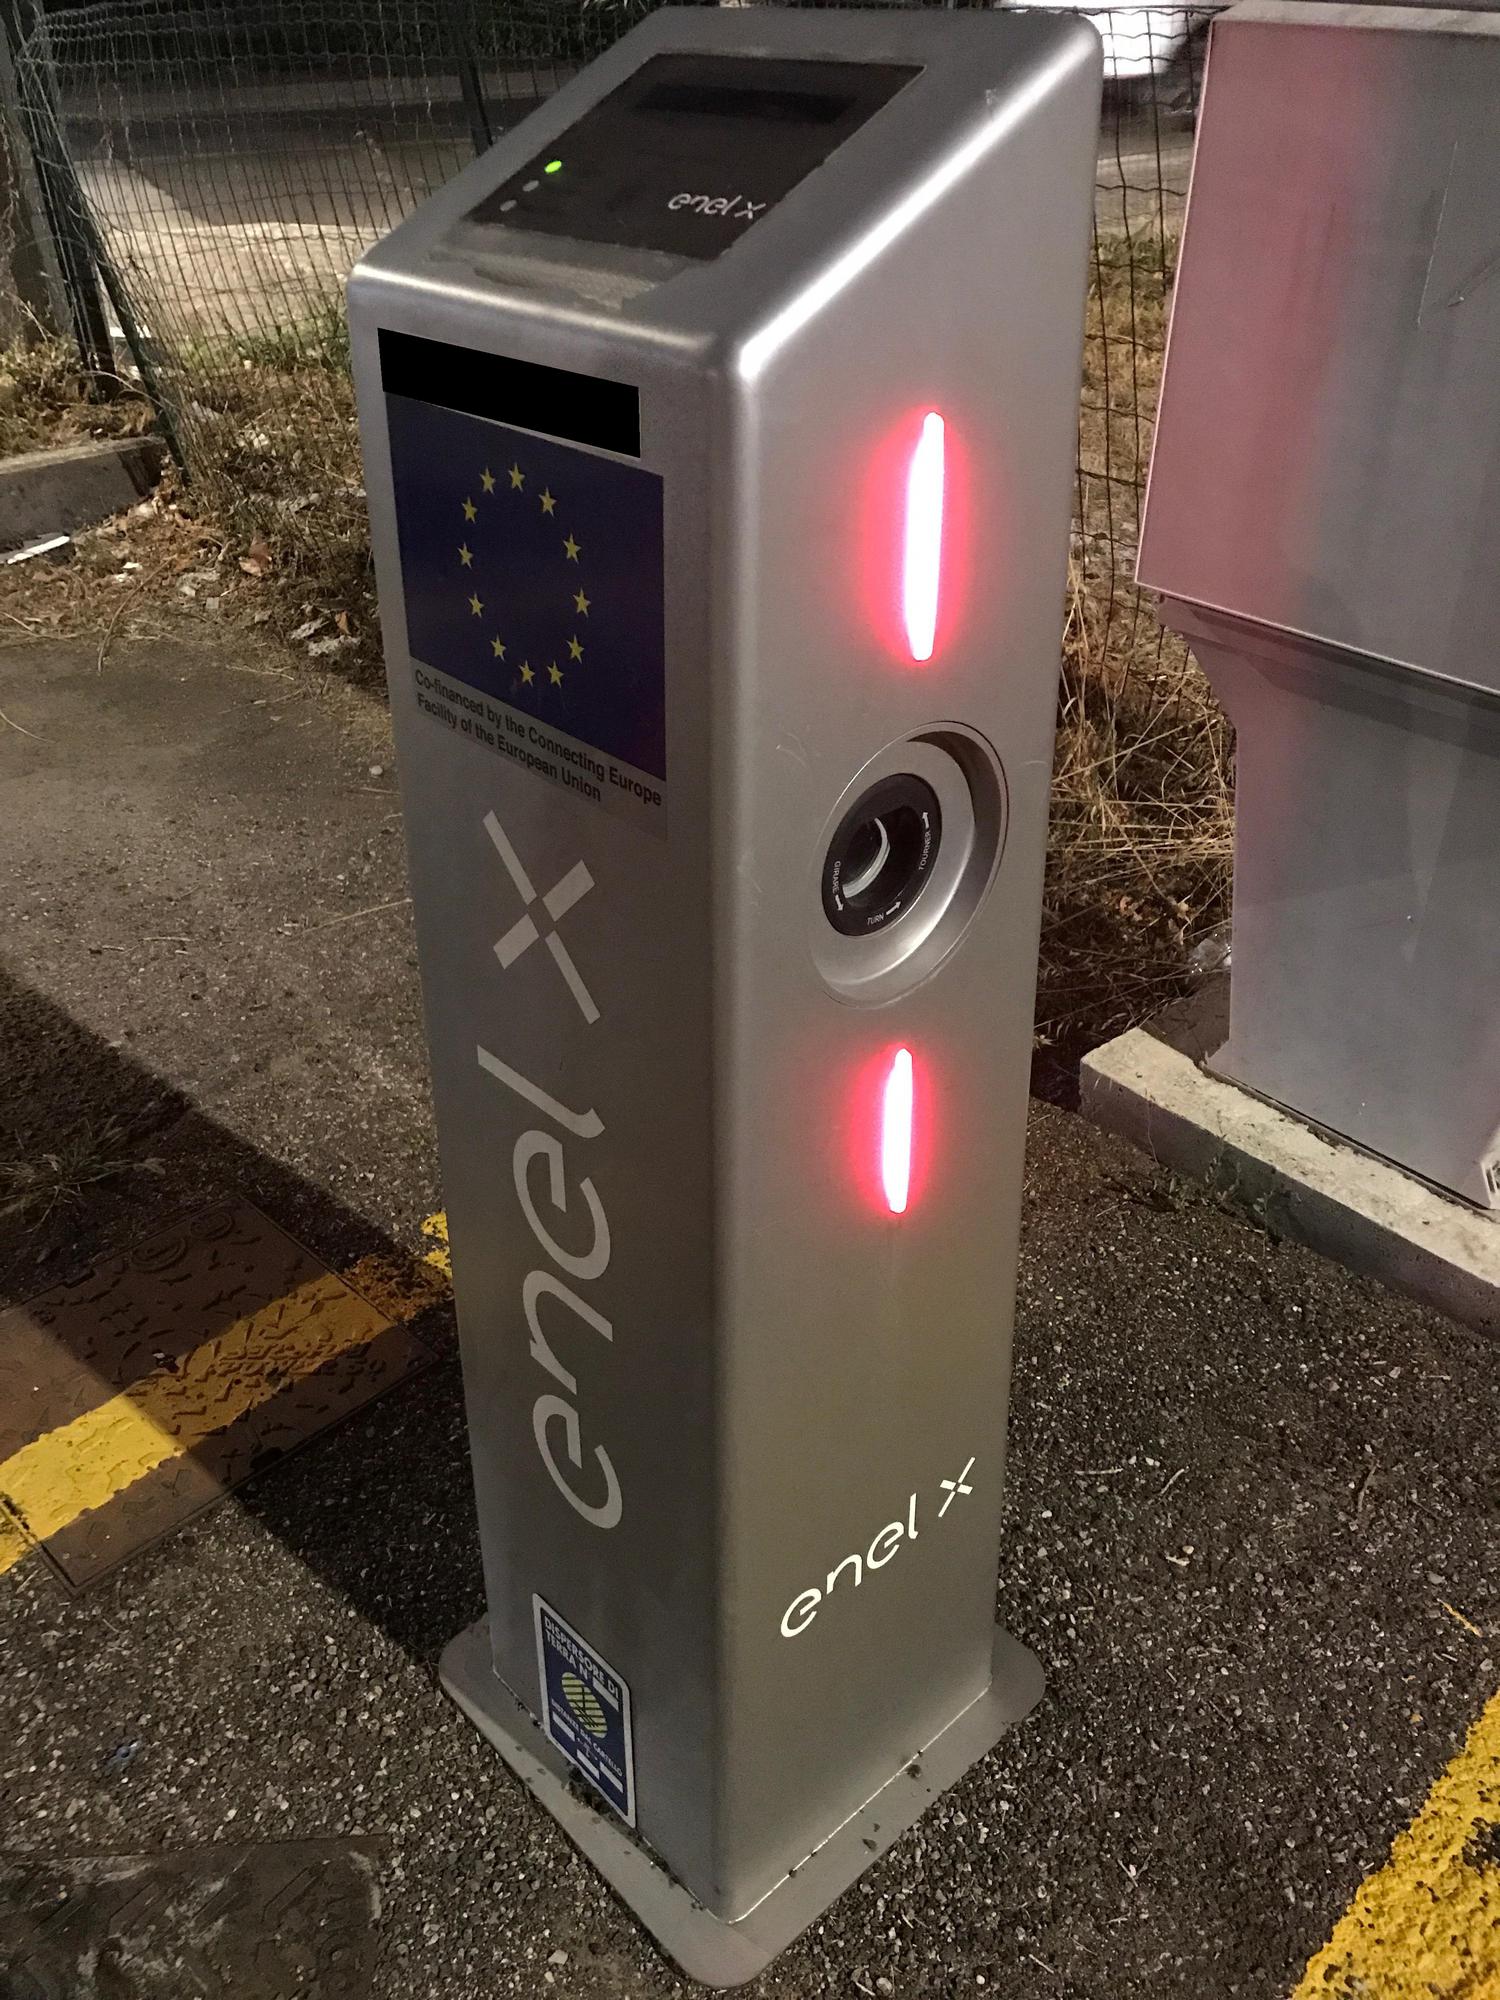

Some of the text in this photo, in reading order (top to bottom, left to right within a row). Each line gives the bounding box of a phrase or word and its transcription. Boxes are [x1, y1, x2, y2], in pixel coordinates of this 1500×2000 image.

[668, 193, 742, 216] enel
[415, 669, 662, 806] Co-financed by the Connecting Europe
[417, 693, 601, 802] Facility of the European Union
[919, 831, 931, 870] TOURNER
[867, 914, 884, 925] TURN
[476, 1044, 624, 1530] enel
[780, 1492, 918, 1638] enel
[544, 1615, 618, 1700] DISPERSORE DI
[545, 1628, 577, 1669] TERRA
